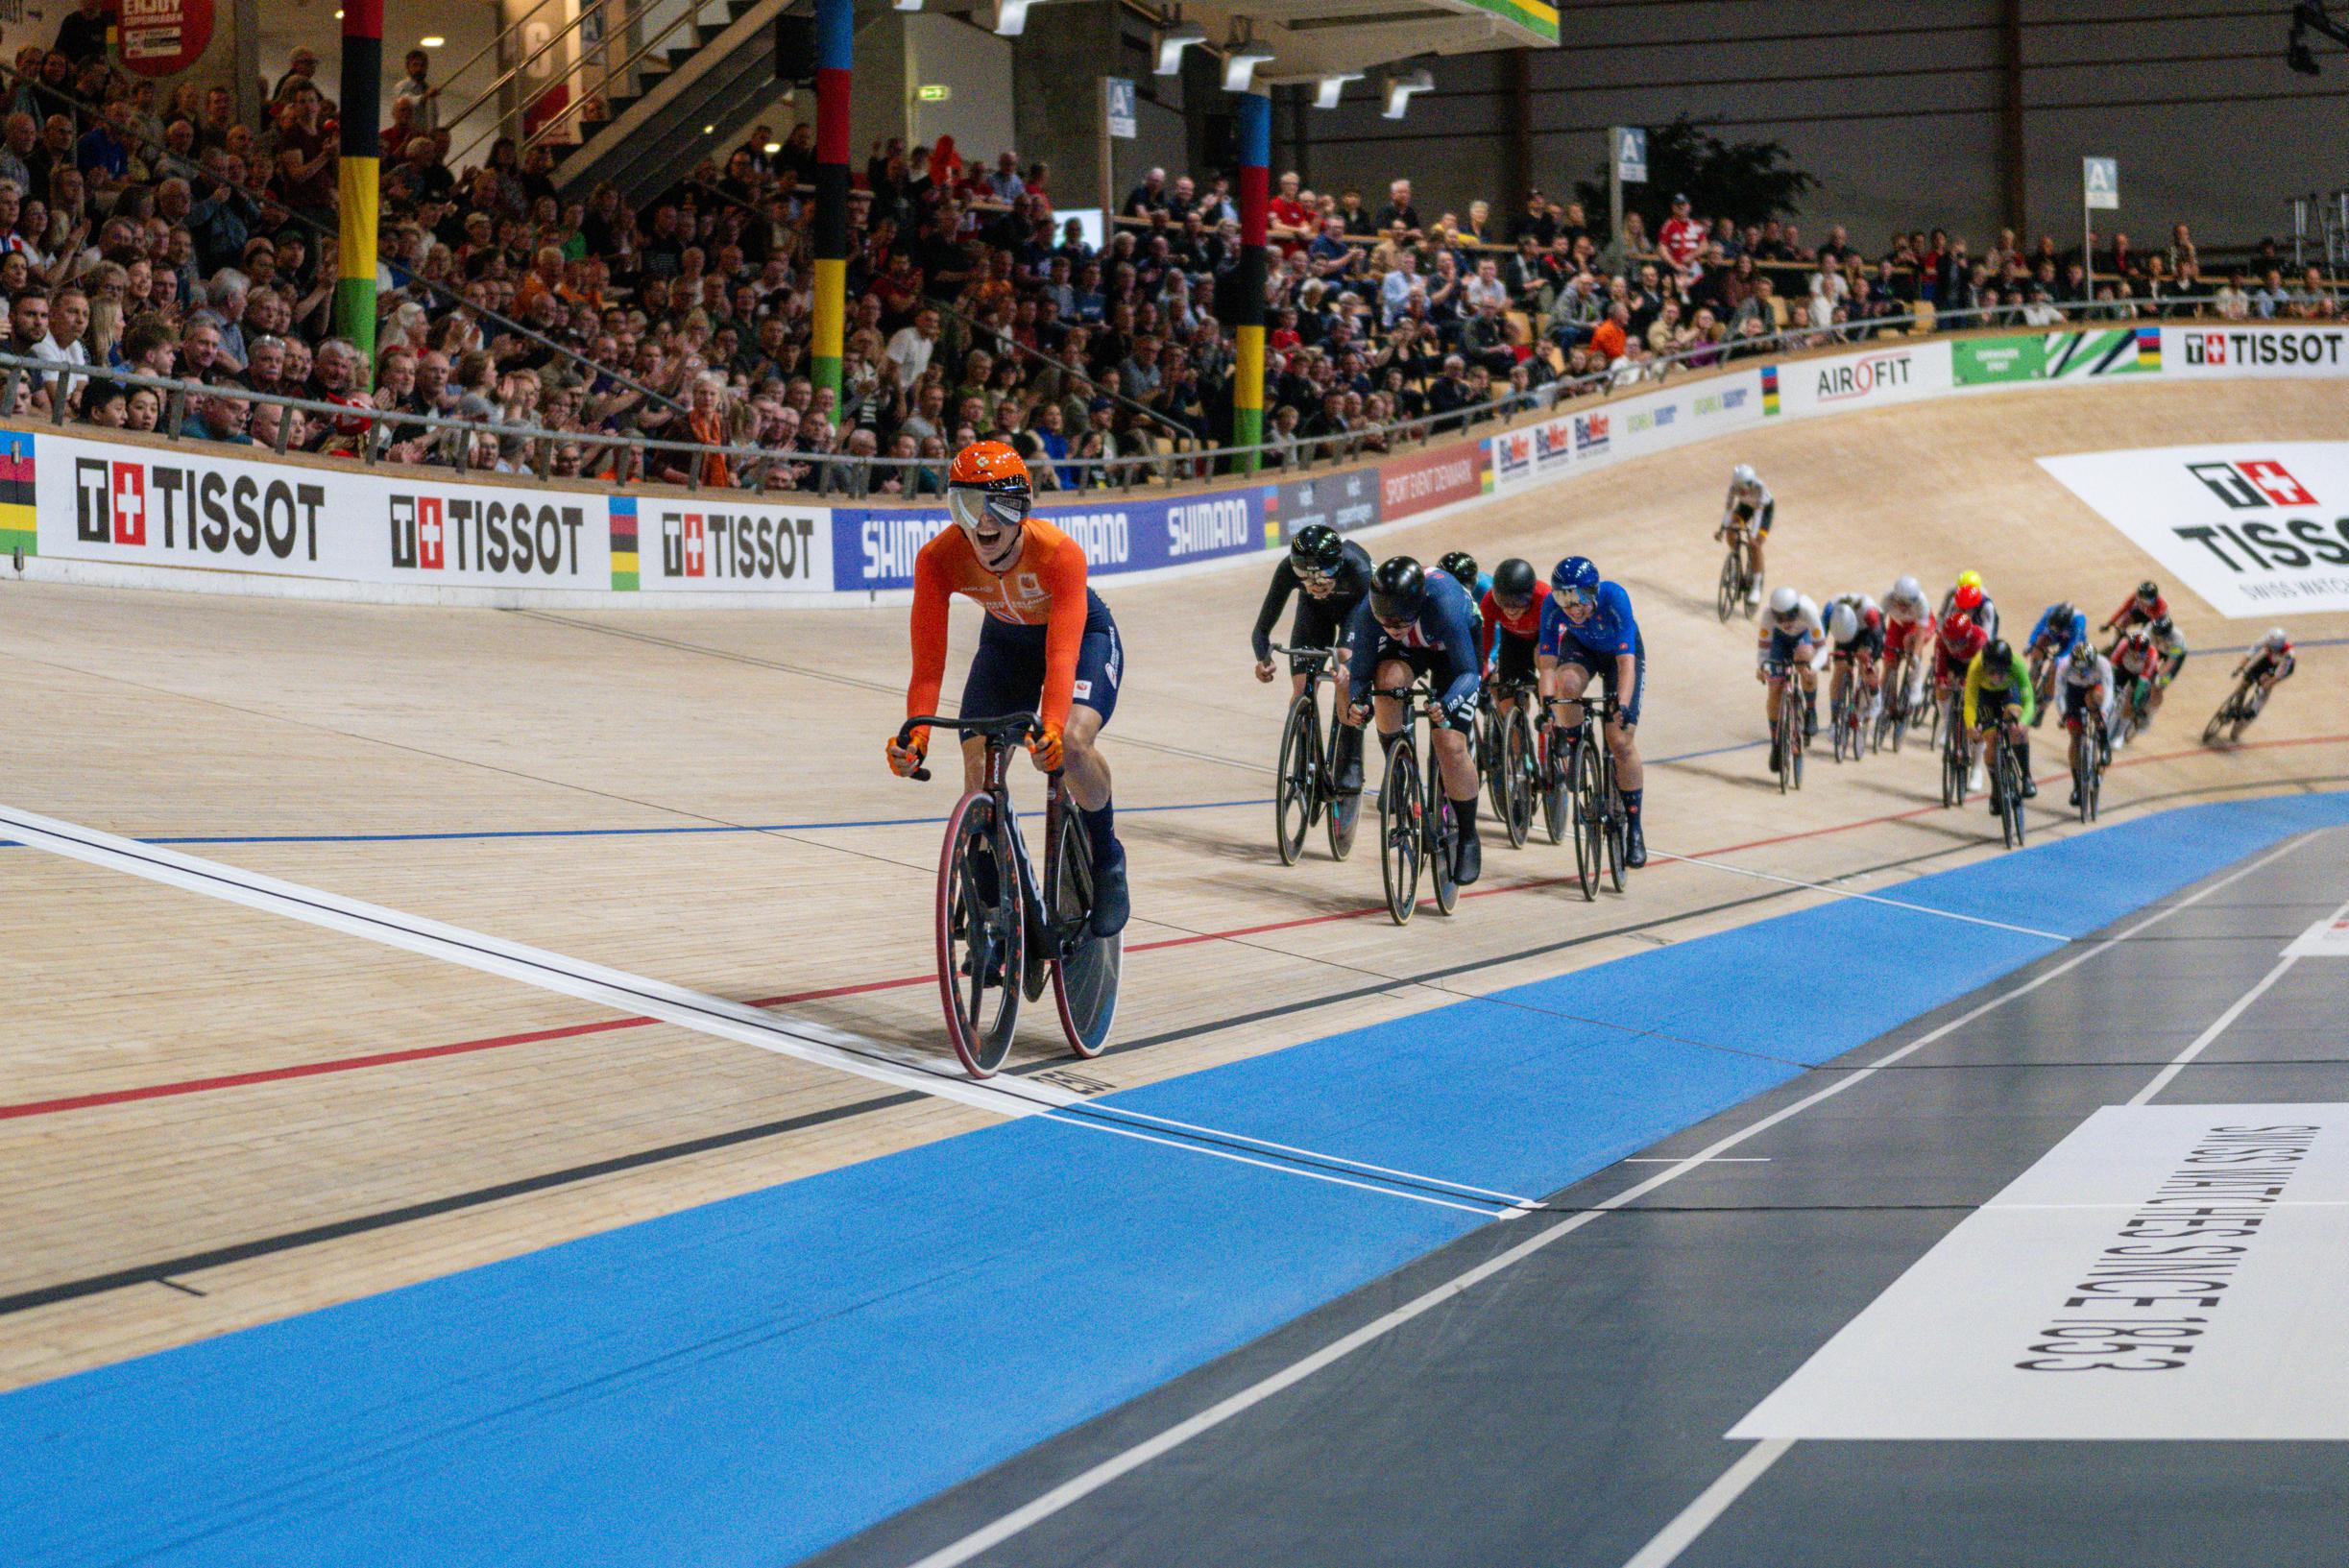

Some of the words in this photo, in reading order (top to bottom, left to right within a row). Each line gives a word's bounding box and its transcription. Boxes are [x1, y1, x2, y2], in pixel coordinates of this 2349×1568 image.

[1817, 356, 1912, 397] AIROFIT
[2230, 334, 2343, 364] TISSOT
[152, 465, 326, 562] TISSOT
[448, 498, 584, 575] TISSOT
[1168, 498, 1248, 557] SHIMANO
[708, 514, 814, 580] TISSOT
[1447, 694, 1465, 713] USA
[2184, 1125, 2322, 1164] SWISS
[2119, 1166, 2297, 1239] WATCHES
[2064, 1245, 2249, 1308] SINCE
[2014, 1316, 2209, 1371] 1853
